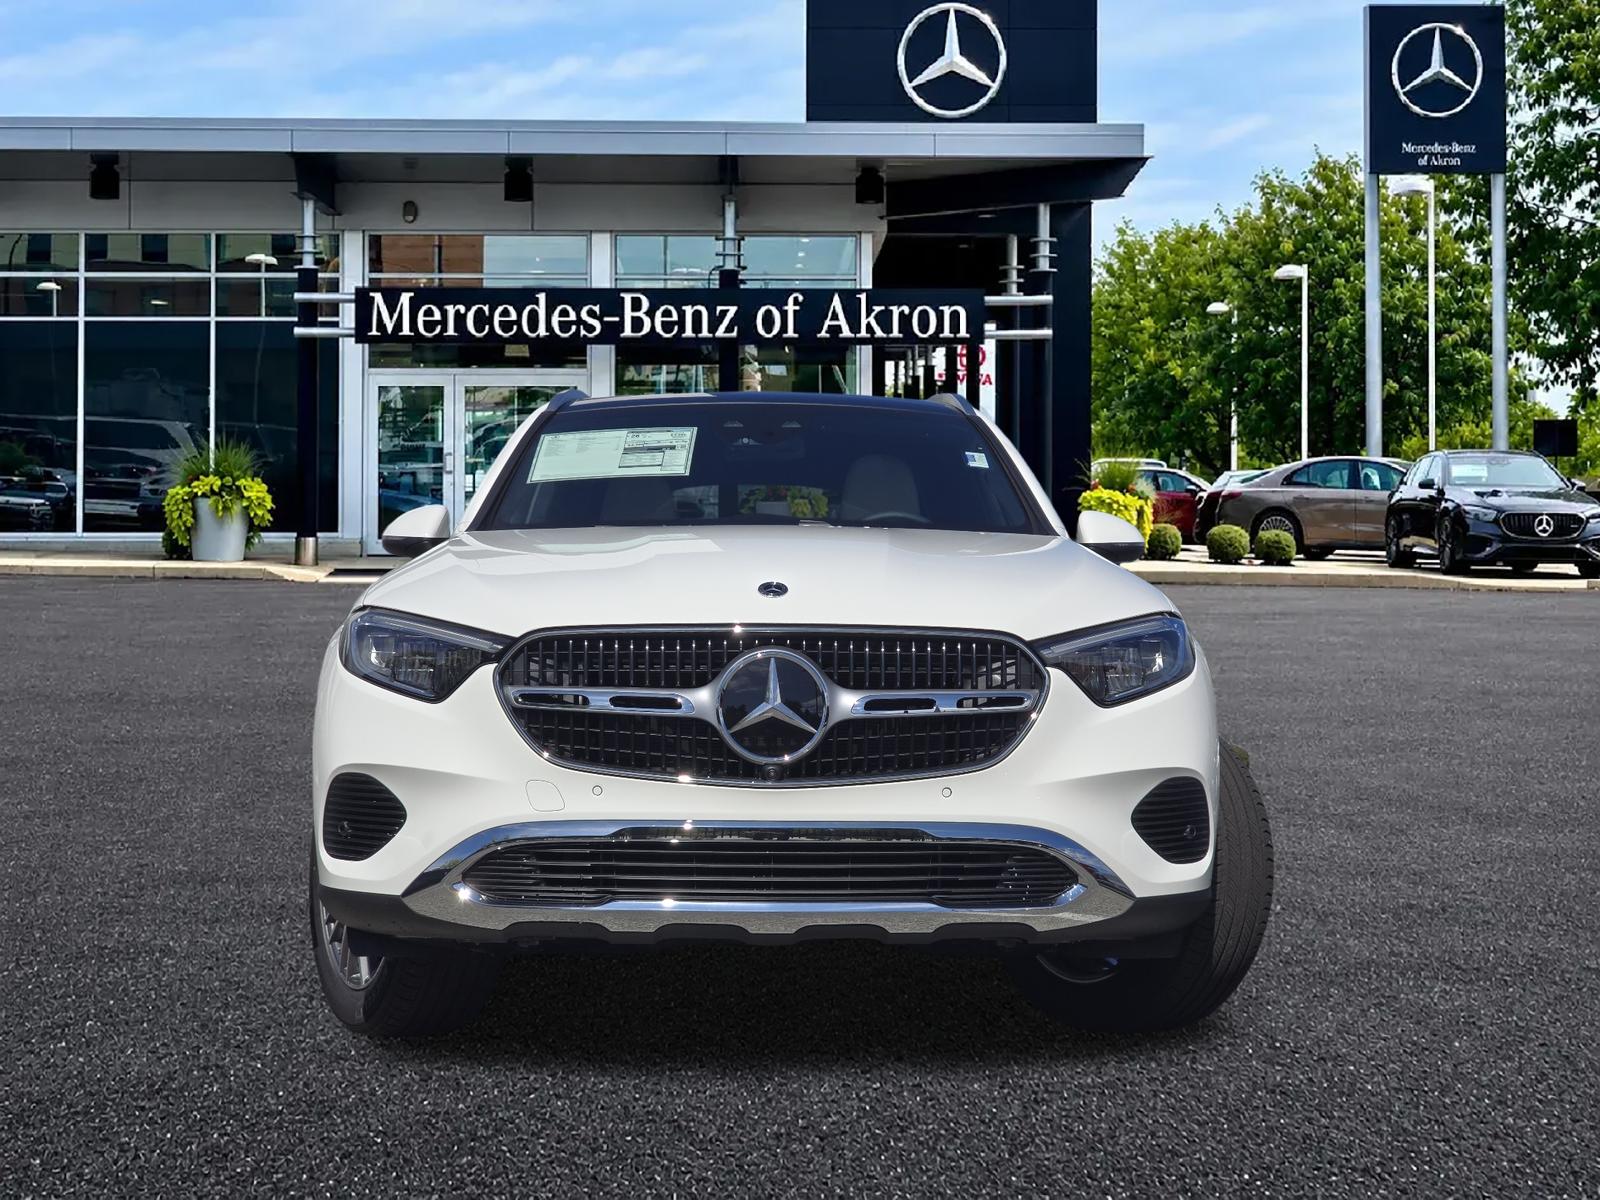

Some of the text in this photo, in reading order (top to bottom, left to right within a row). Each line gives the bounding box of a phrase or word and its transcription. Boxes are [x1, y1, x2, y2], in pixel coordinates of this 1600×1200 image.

[1401, 142, 1476, 153] Mercedes-Benz
[1417, 154, 1460, 166] of Akron
[368, 292, 970, 338] Mercedes-Benz of Akron
